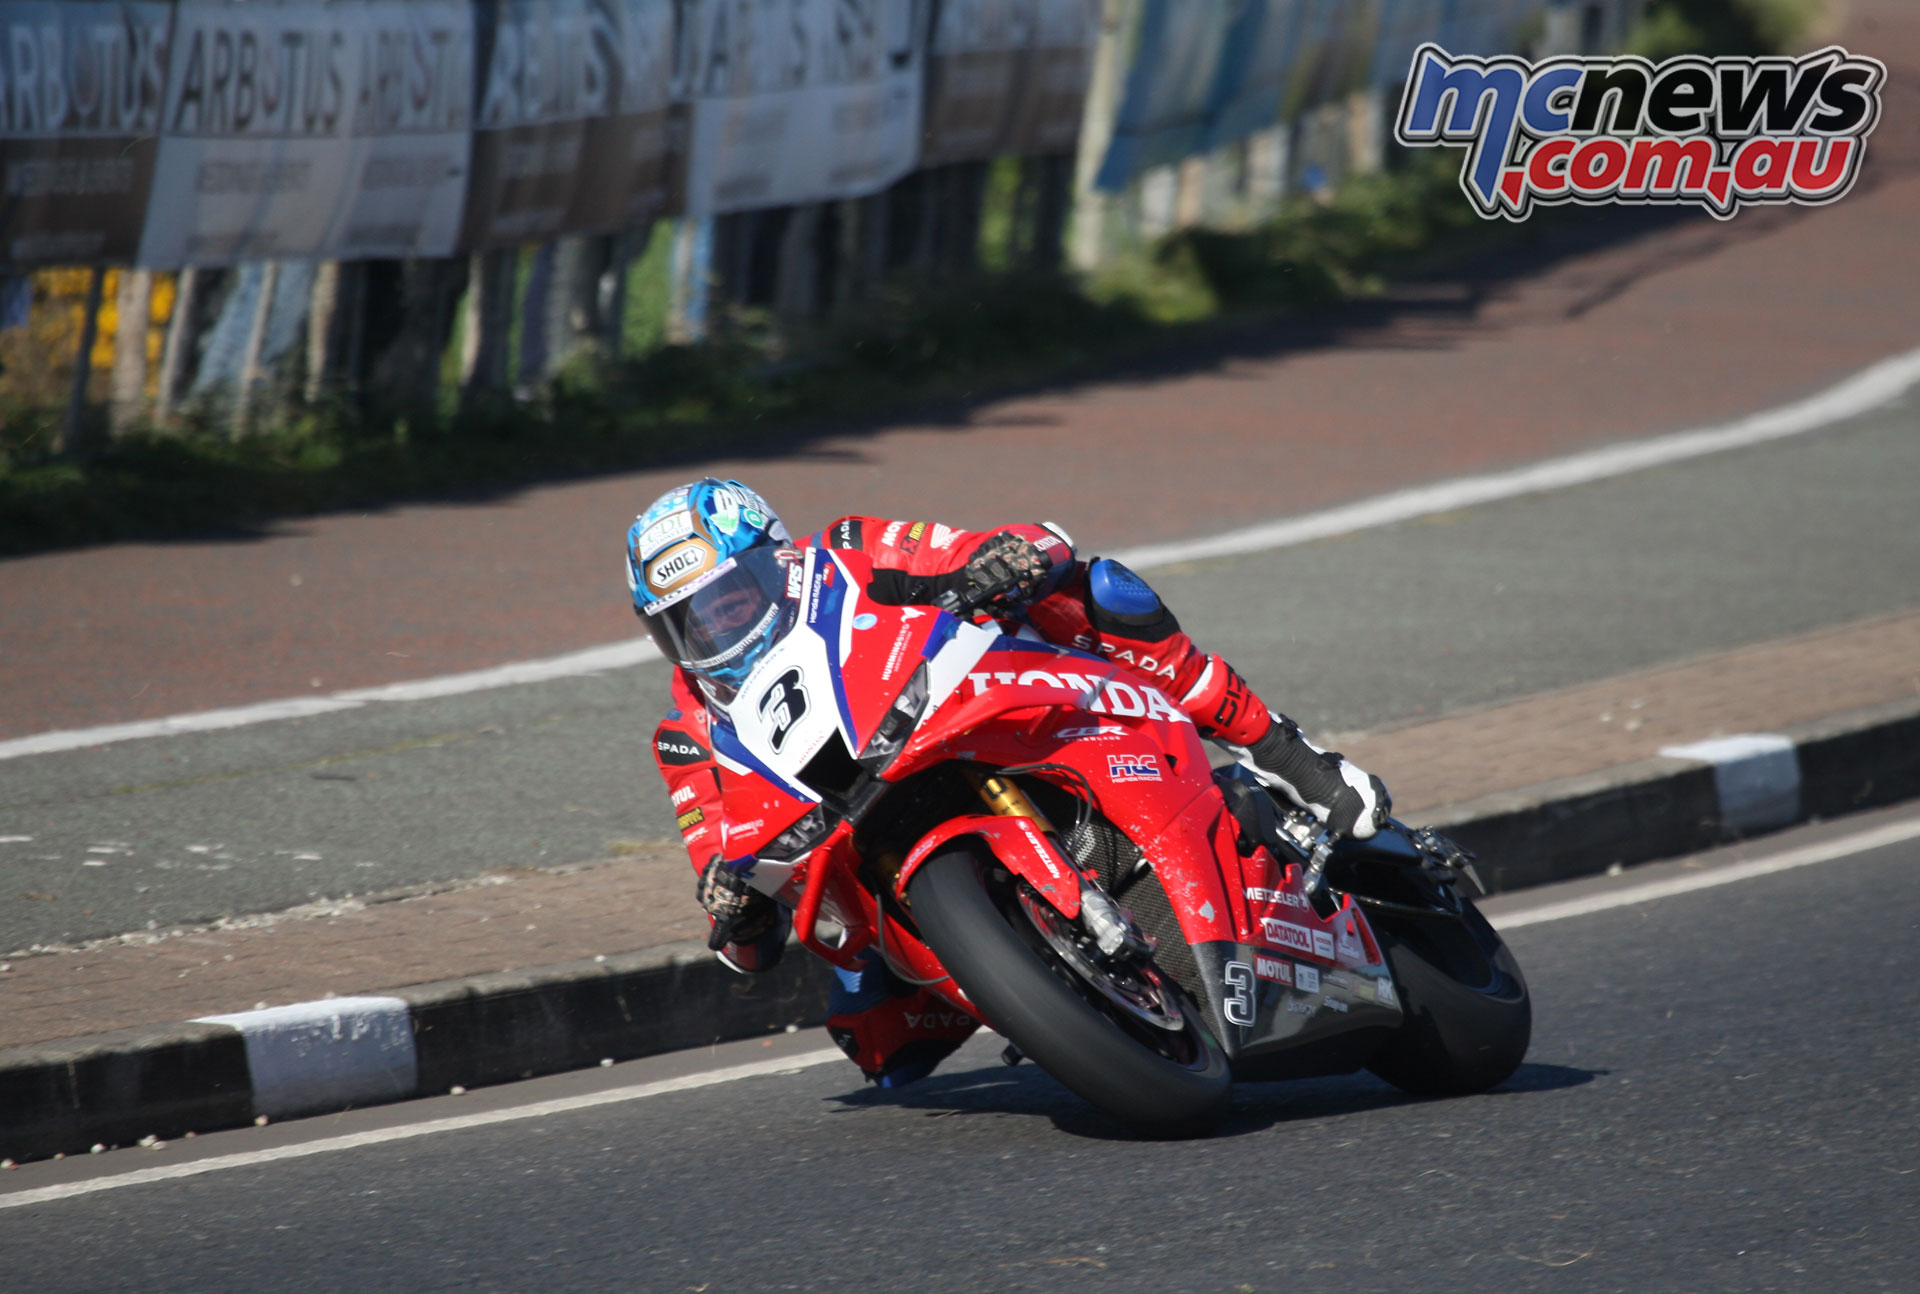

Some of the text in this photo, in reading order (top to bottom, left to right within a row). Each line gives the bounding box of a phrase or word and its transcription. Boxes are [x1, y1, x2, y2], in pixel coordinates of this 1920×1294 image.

[656, 549, 699, 582] SHOEI
[1071, 634, 1177, 681] SPADA
[756, 665, 812, 755] 3
[968, 670, 1193, 724] HONDA
[1056, 726, 1129, 738] CBR
[657, 741, 701, 756] SPADA
[1106, 754, 1160, 778] HRC
[1265, 922, 1311, 949] DATATOOL
[1256, 957, 1292, 984] MOTUL
[1223, 960, 1257, 1028] 3
